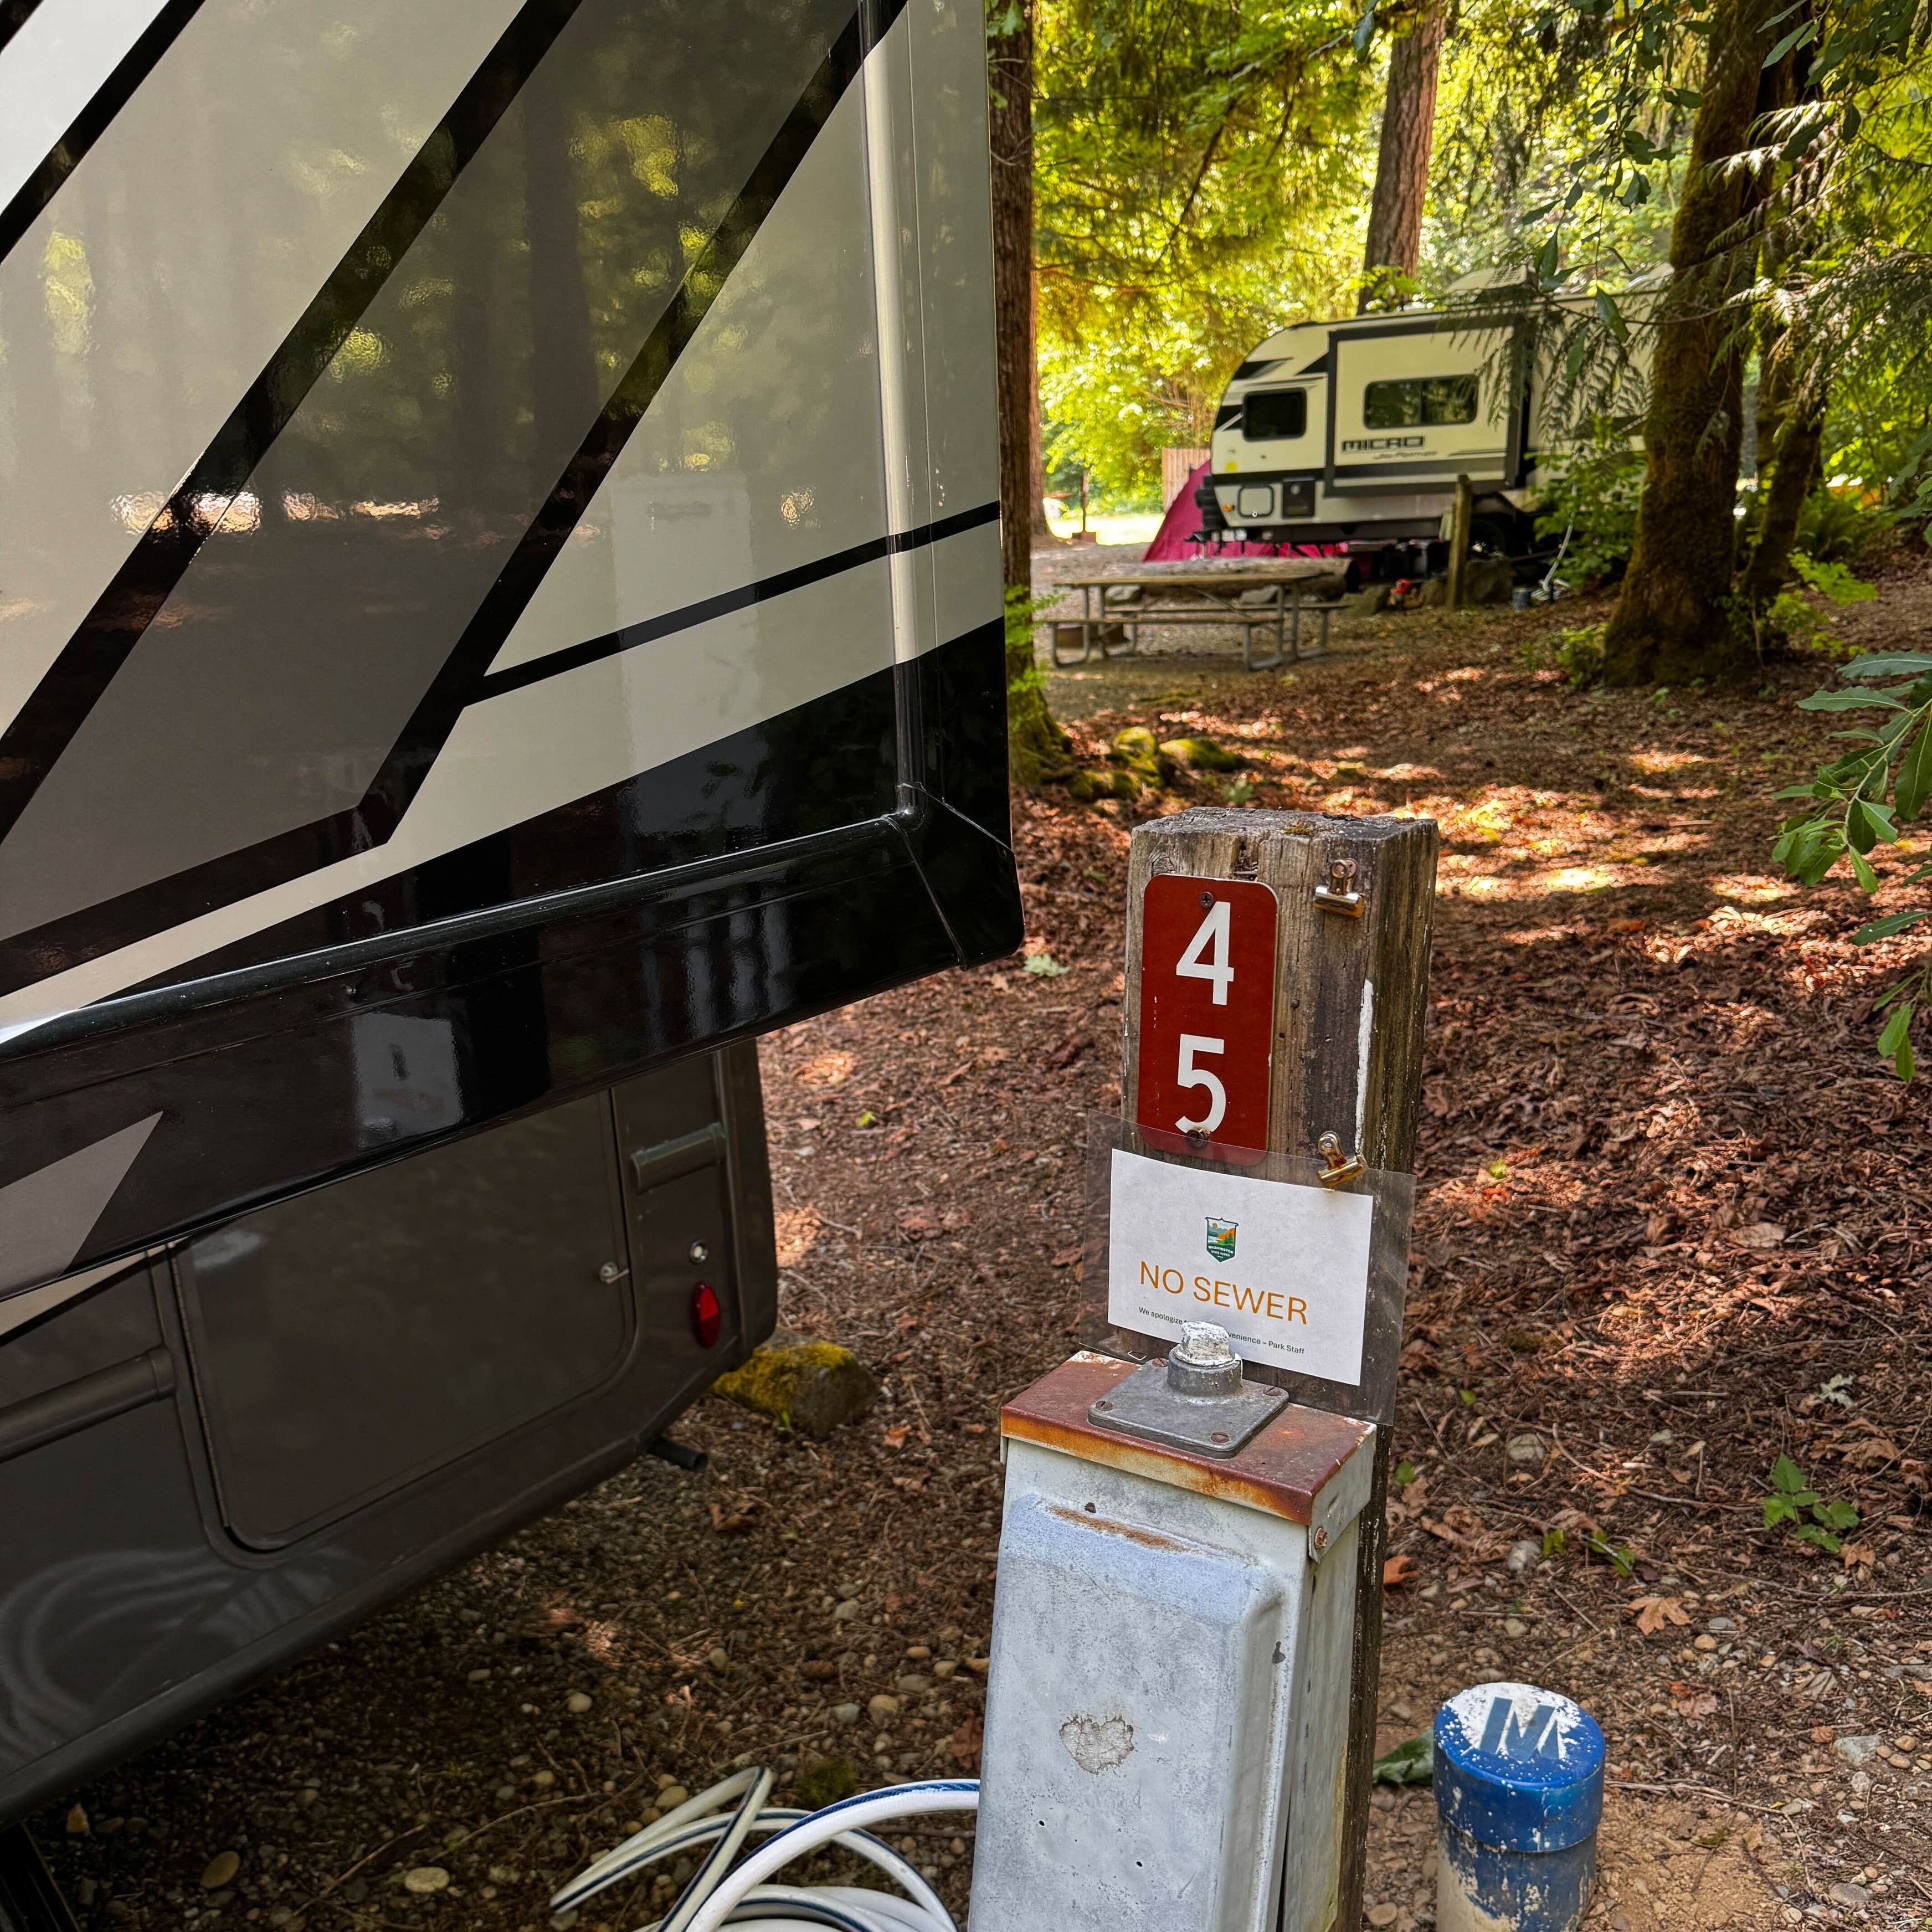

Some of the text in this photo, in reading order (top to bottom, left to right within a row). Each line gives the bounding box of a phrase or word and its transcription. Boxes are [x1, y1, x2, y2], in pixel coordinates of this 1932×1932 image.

[1343, 436, 1424, 451] MICRO
[1176, 901, 1234, 1005] 4
[1175, 1033, 1226, 1133] 5
[1140, 1261, 1308, 1325] NO SEWER
[1139, 1306, 1149, 1315] We
[1151, 1311, 1183, 1325] apologize
[1227, 1332, 1261, 1345] venience
[1268, 1340, 1284, 1350] Park
[1286, 1344, 1304, 1354] Staff
